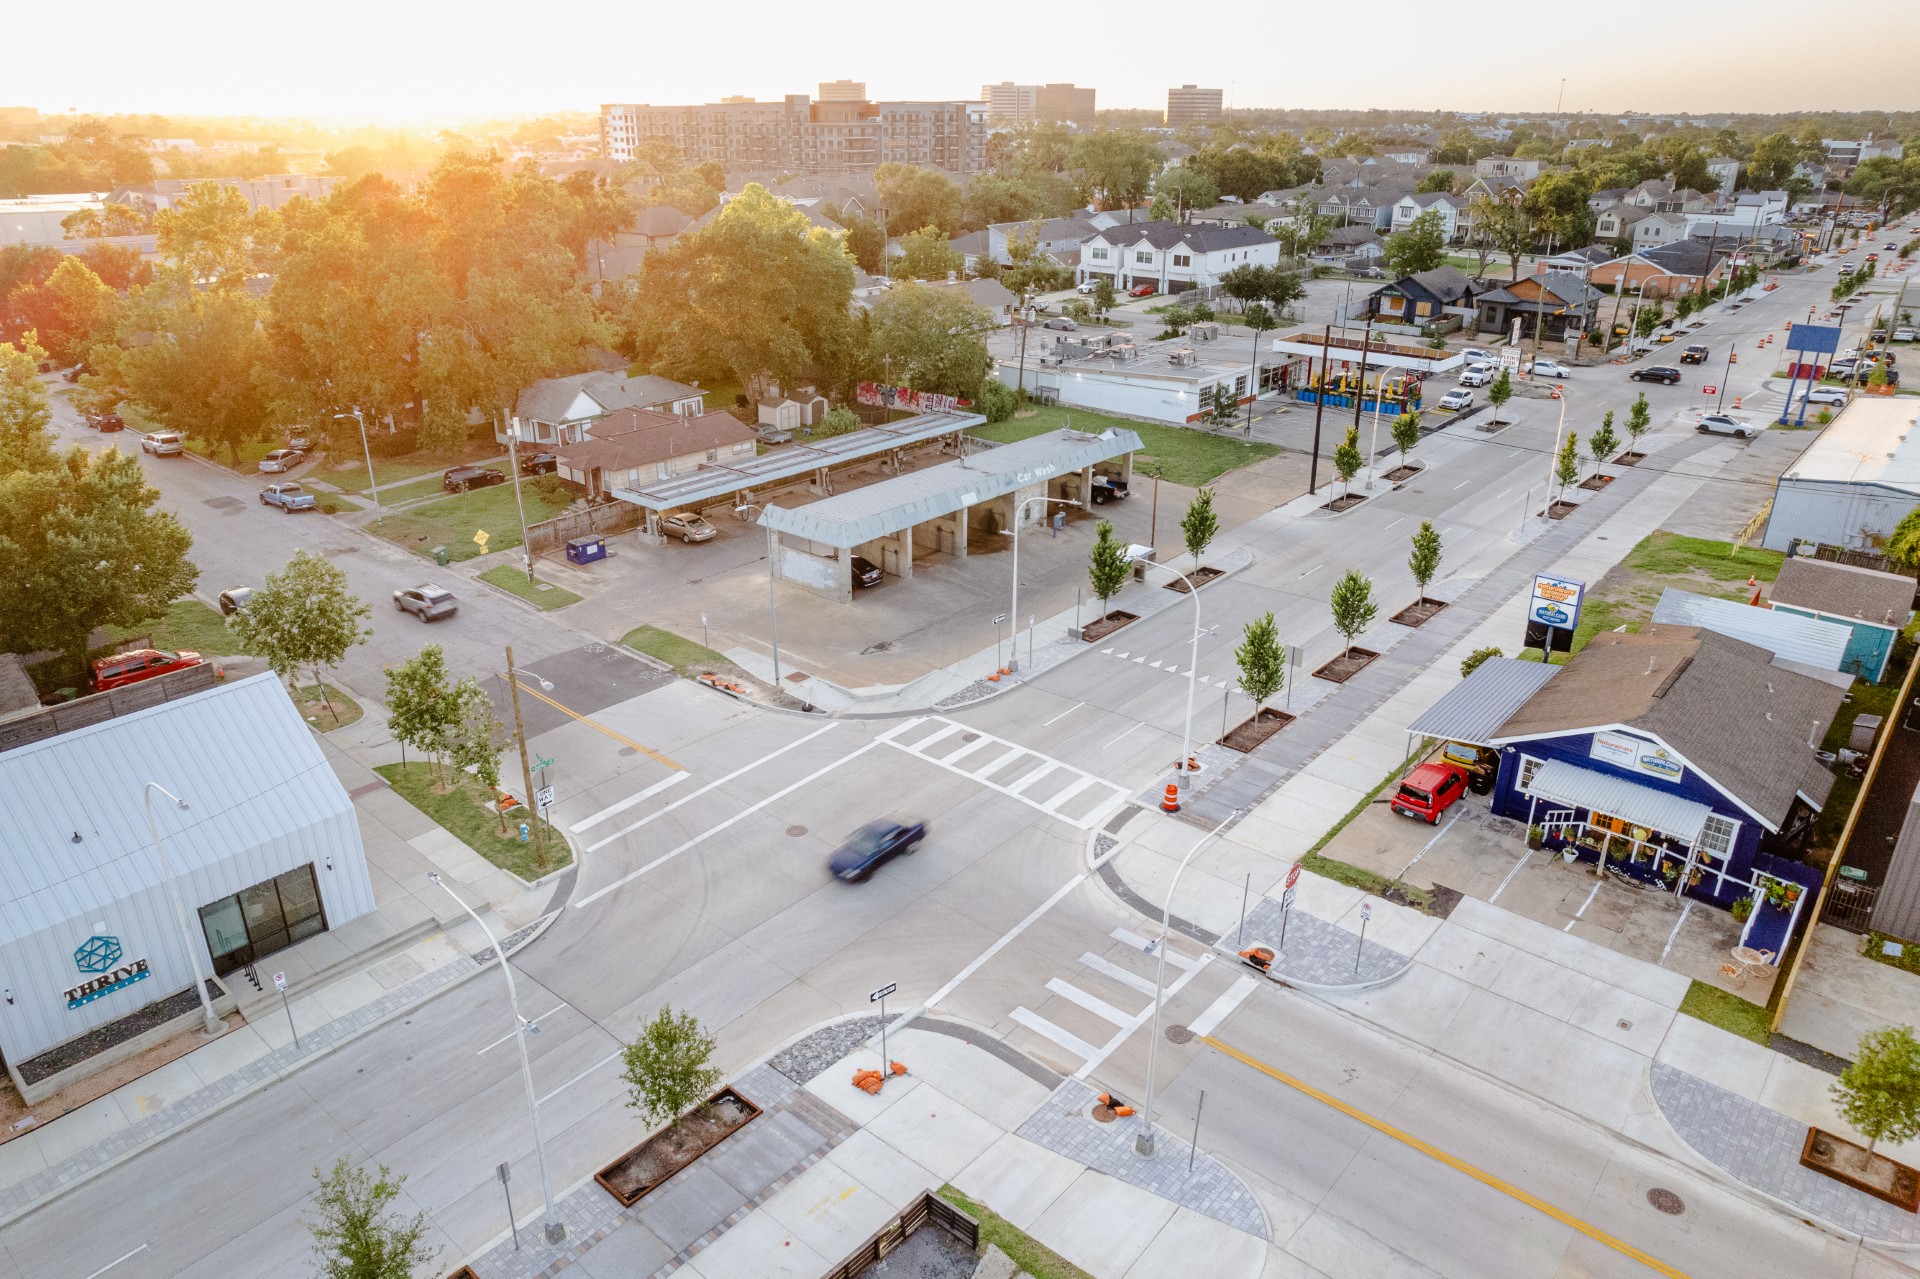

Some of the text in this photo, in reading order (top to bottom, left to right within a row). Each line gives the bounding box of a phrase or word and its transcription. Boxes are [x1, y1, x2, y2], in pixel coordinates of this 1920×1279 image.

[1017, 463, 1056, 483] Car Wash
[1642, 756, 1680, 770] NATURALCARE
[539, 792, 553, 802] WAY
[540, 788, 551, 797] ONE
[1286, 867, 1301, 886] STOP
[64, 959, 149, 1002] THRIVE
